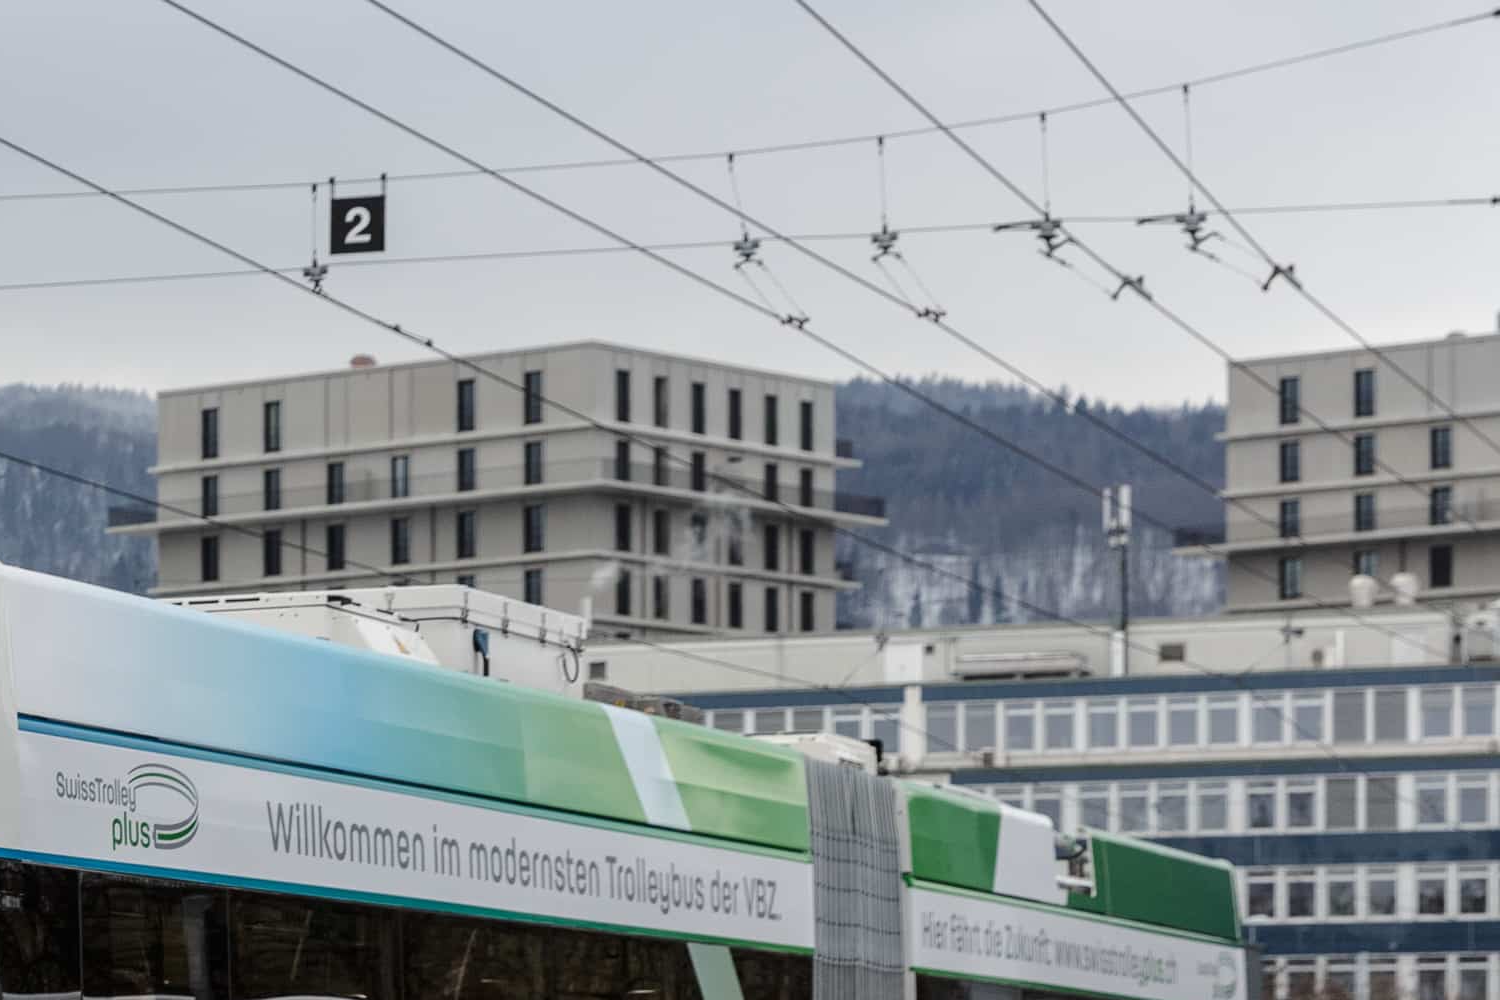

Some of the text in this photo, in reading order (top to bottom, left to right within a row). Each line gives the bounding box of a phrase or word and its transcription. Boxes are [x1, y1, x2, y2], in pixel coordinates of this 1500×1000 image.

[344, 206, 371, 244] 2
[56, 771, 137, 812] SwissTrolley
[112, 811, 151, 851] plus
[266, 800, 782, 922] Willkommen im modernsten Trolleybus der VBZ.
